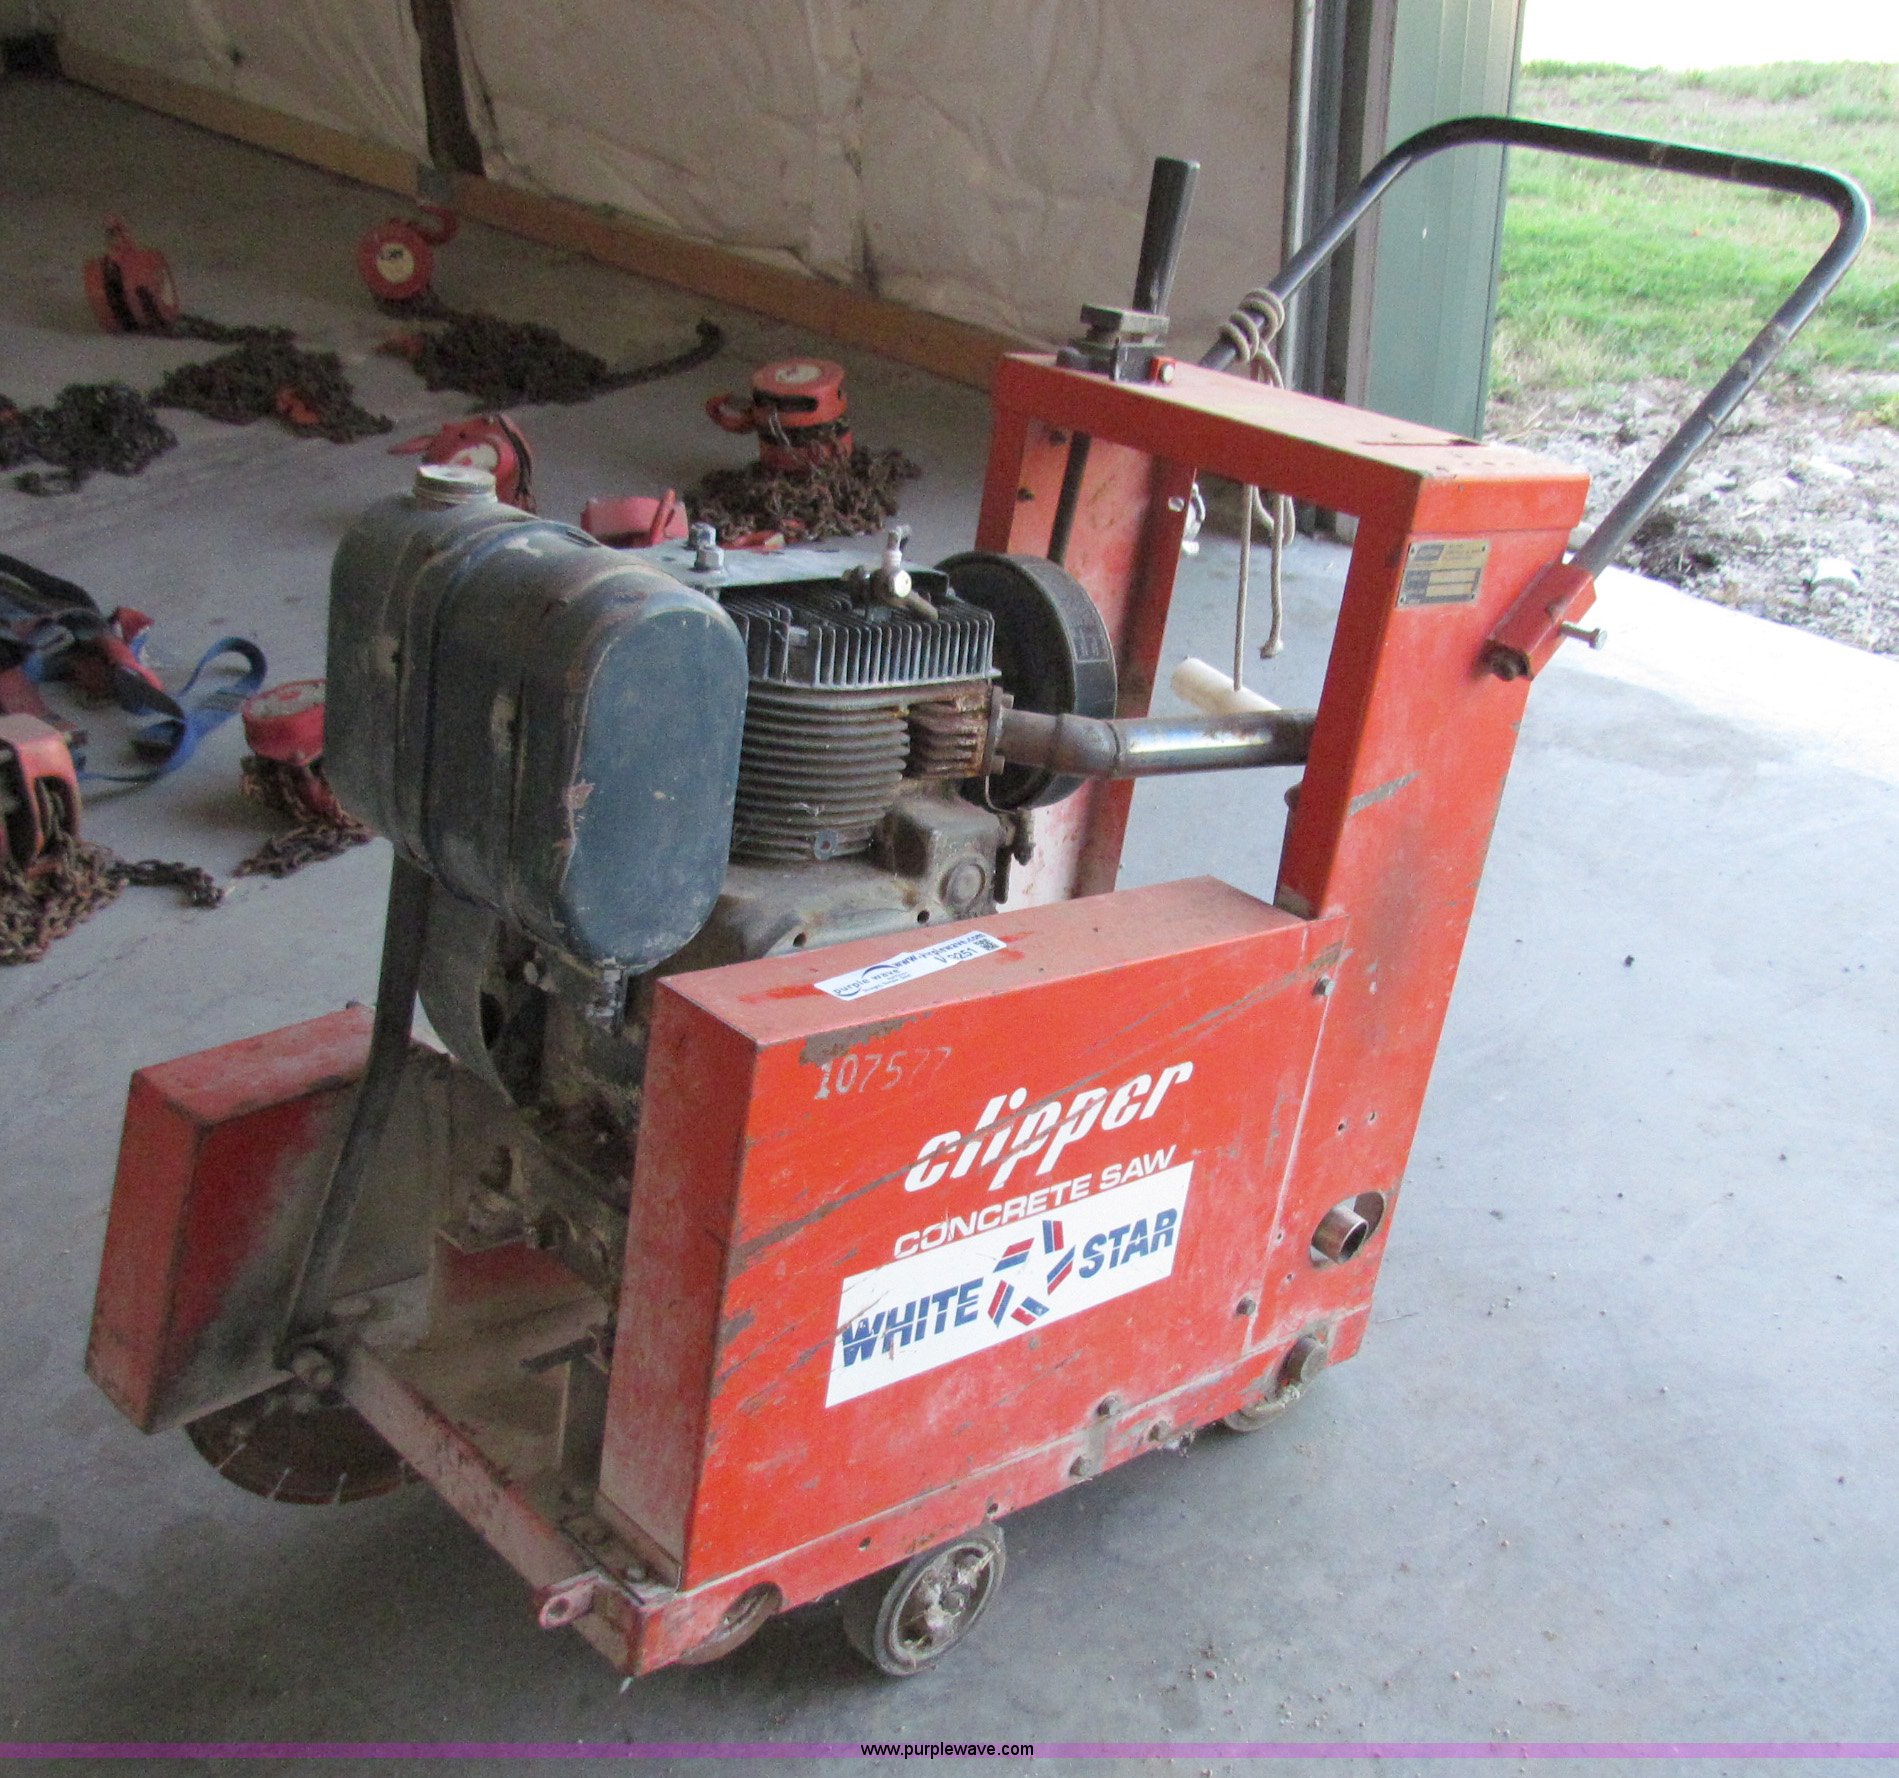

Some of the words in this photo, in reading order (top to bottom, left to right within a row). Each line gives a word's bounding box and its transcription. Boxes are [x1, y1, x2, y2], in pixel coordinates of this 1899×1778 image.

[833, 979, 869, 994] purple
[814, 1046, 952, 1100] 107577
[894, 1173, 1093, 1260] CONCRETE
[1099, 1145, 1177, 1190] SAW
[842, 1277, 984, 1367] WHITE
[1078, 1208, 1178, 1279] STAR
